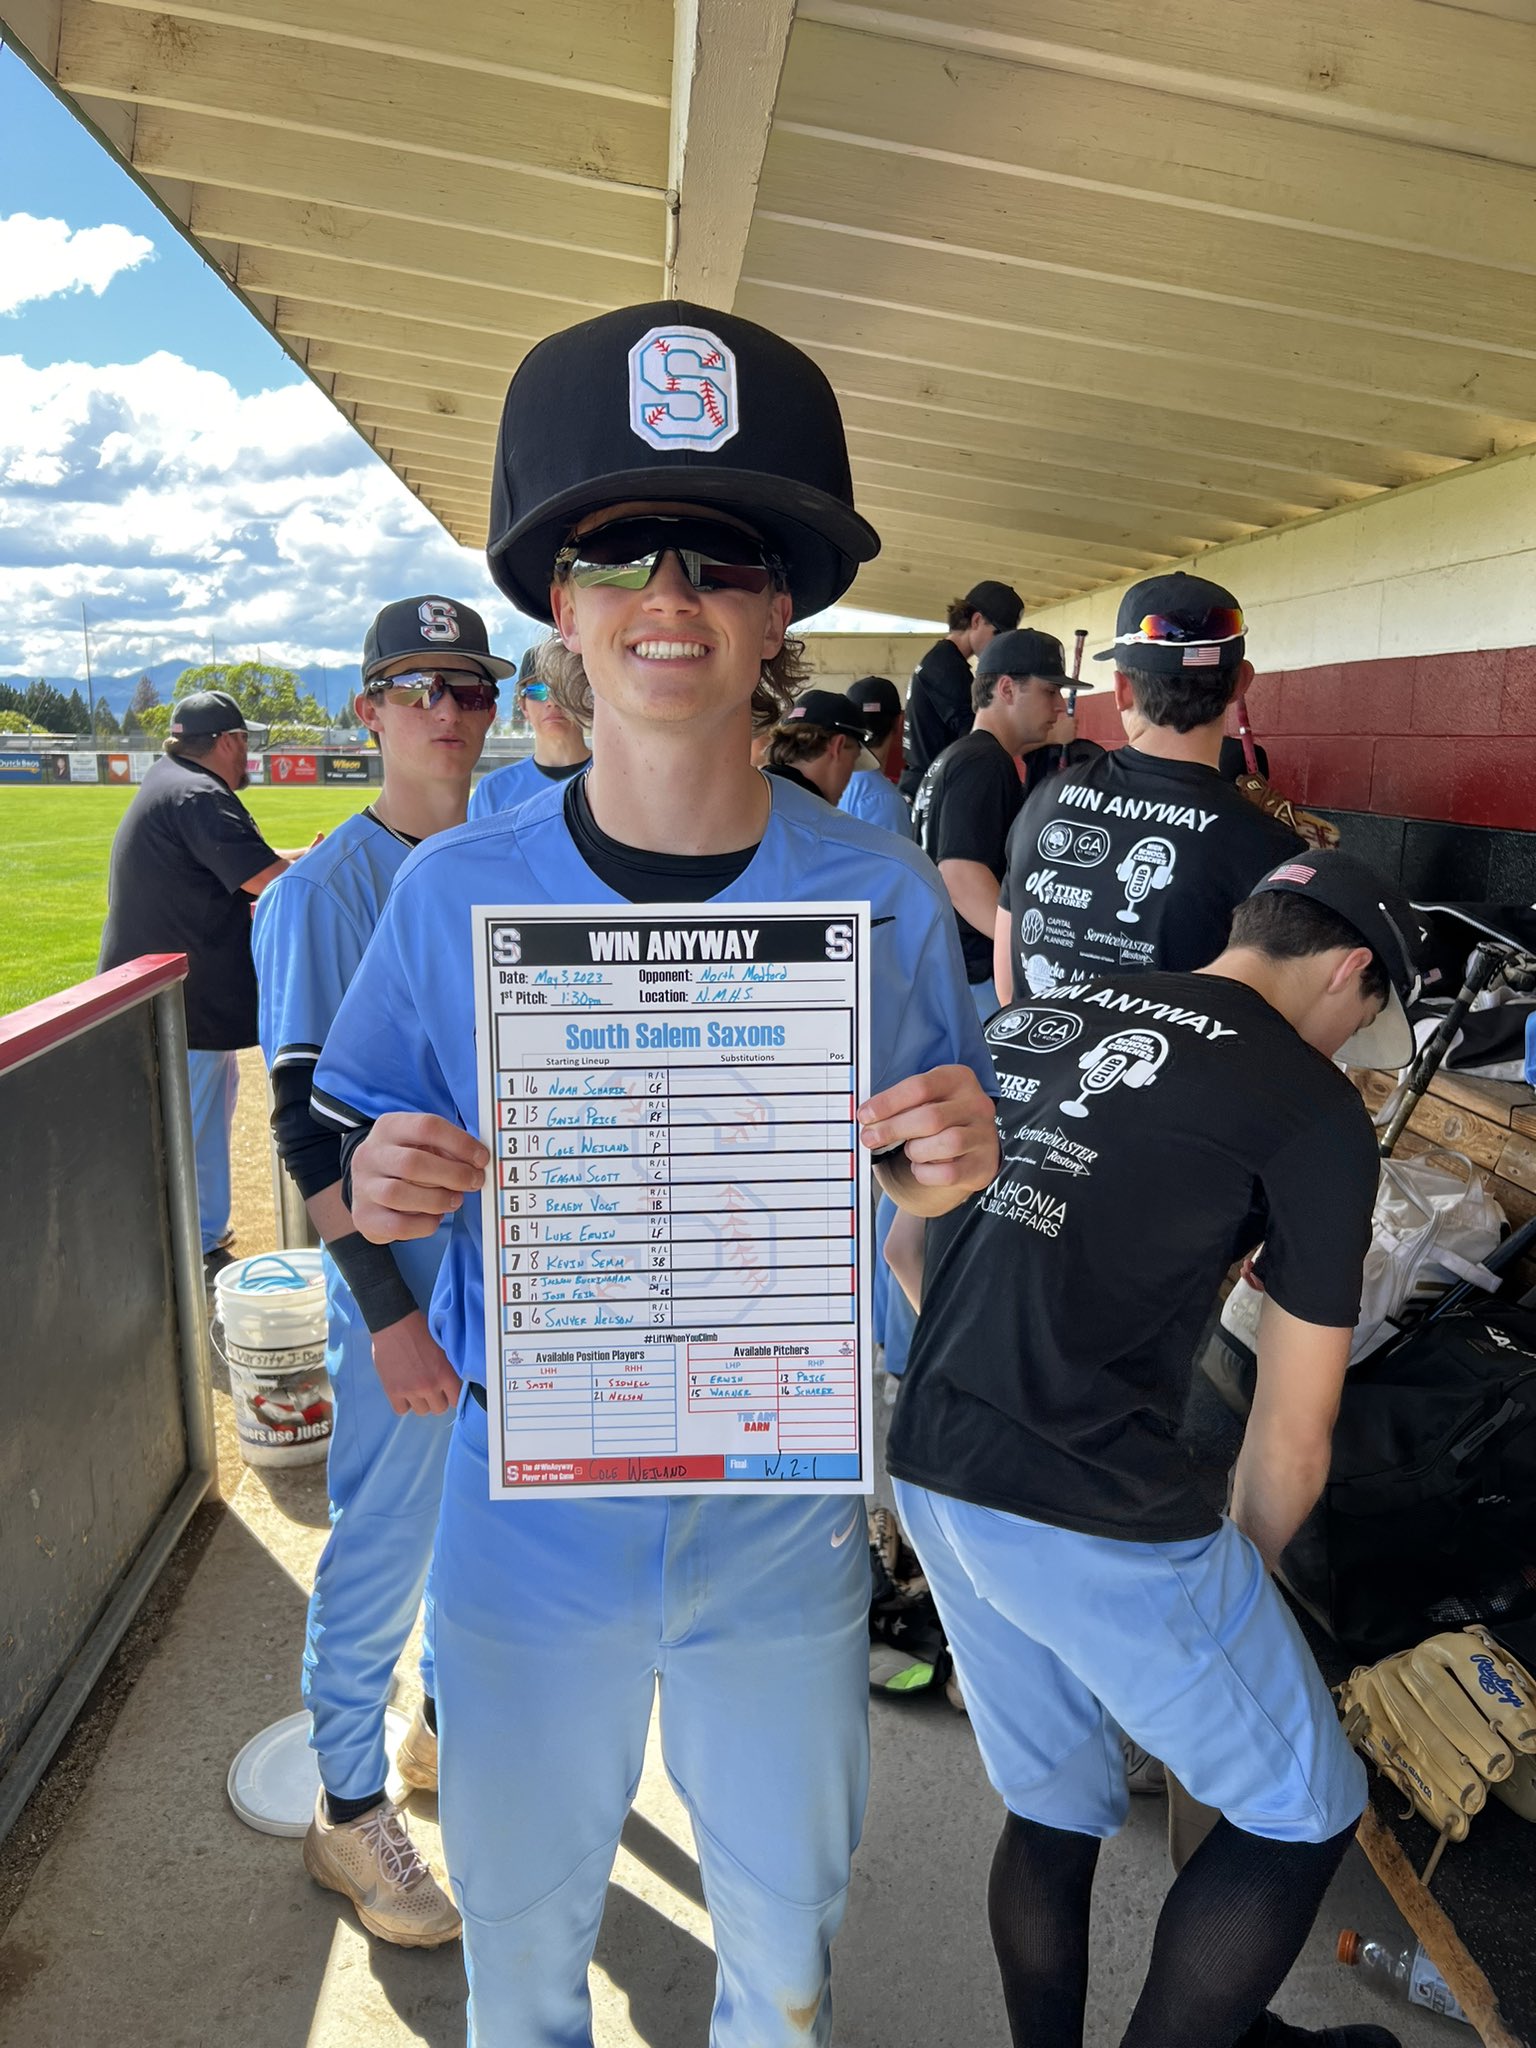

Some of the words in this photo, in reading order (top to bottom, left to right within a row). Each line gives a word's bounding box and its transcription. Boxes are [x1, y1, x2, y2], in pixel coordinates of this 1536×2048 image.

[628, 325, 739, 452] S
[418, 599, 460, 642] S
[1057, 784, 1104, 812] WIN
[1102, 795, 1219, 833] ANYWAY
[1078, 836, 1101, 853] GA
[1131, 868, 1148, 893] CLUB
[1054, 883, 1093, 902] TIRE
[1052, 895, 1089, 910] STORES
[1047, 918, 1071, 929] CAPITAL
[1043, 935, 1074, 948] PLANNERS
[1045, 927, 1076, 939] FINANCIAL
[493, 928, 521, 964] S
[589, 932, 640, 961] WIN
[646, 930, 759, 960] ANYWAY
[825, 924, 853, 960] S
[500, 971, 529, 984] Date:
[535, 970, 558, 989] May
[573, 972, 603, 983] 2023
[639, 969, 693, 985] Opponent:
[701, 965, 735, 982] North
[742, 963, 787, 982] Medford
[516, 991, 548, 1005] Pitch:
[639, 989, 689, 1003] Location:
[1031, 983, 1092, 1001] WIN
[1083, 987, 1239, 1041] ANYWAY
[566, 1023, 629, 1050] South
[636, 1022, 701, 1048] Salem
[707, 1021, 785, 1047] Saxons
[1038, 1020, 1069, 1039] GA
[1115, 1037, 1155, 1054] SCHOOL
[1129, 1034, 1155, 1045] HIGH
[721, 1054, 775, 1063] Substitutions
[1107, 1042, 1154, 1061] COACHES
[546, 1057, 580, 1067] Starting
[581, 1057, 610, 1066] Lineup
[1091, 1058, 1123, 1084] CLUB
[508, 1078, 515, 1095] 1
[525, 1075, 538, 1094] 16
[548, 1077, 578, 1095] NOAH
[649, 1083, 662, 1094] CF
[1001, 1088, 1032, 1103] ORES
[507, 1108, 517, 1125] 2
[525, 1105, 538, 1124] 13
[546, 1107, 580, 1127] GAVIN
[586, 1107, 617, 1125] PRICE
[649, 1112, 662, 1122] RF
[508, 1137, 518, 1154] 3
[528, 1135, 540, 1153] 19
[546, 1137, 575, 1157] COLE
[653, 1142, 661, 1154] P
[1046, 1150, 1082, 1172] Restore
[508, 1167, 519, 1183] 4
[529, 1161, 540, 1182] 5
[586, 1165, 621, 1183] SCOTT
[654, 1171, 663, 1180] C
[510, 1196, 520, 1213] 5
[528, 1193, 537, 1209] 3
[590, 1195, 620, 1211] VOGT
[1005, 1205, 1061, 1237] AFFAIRS
[510, 1225, 520, 1242] 6
[530, 1221, 538, 1239] 4
[545, 1226, 572, 1241] LUKE
[579, 1225, 616, 1242] ERWIN
[652, 1228, 663, 1238] LF
[511, 1254, 521, 1271] 7
[530, 1251, 539, 1270] 8
[546, 1255, 584, 1271] KEVIN
[652, 1257, 665, 1267] 3B
[512, 1282, 522, 1300] 8
[530, 1278, 537, 1287] 2
[531, 1293, 538, 1301] 11
[543, 1291, 566, 1300] JOSH
[512, 1311, 522, 1328] 9
[531, 1308, 541, 1324] 6
[594, 1306, 633, 1325] NELSON
[652, 1313, 665, 1323] SS
[644, 1333, 718, 1345] #LiftWhenYouClimb
[535, 1351, 575, 1363] Available
[576, 1350, 610, 1361] Position
[612, 1349, 645, 1361] Players
[734, 1346, 772, 1357] Available
[773, 1345, 809, 1356] Pitchers
[540, 1367, 557, 1375] LHH
[807, 1359, 824, 1367] RHP
[508, 1380, 519, 1390] 12
[526, 1380, 554, 1390] SMITH
[691, 1375, 697, 1384] 4
[709, 1375, 743, 1383] ERWIN
[780, 1373, 789, 1382] 13
[796, 1372, 826, 1382] PRICE
[594, 1391, 603, 1402] 21
[608, 1393, 643, 1401] NELSON
[691, 1389, 701, 1397] 15
[710, 1388, 752, 1397] WAGNER
[781, 1386, 790, 1395] 16
[737, 1412, 755, 1422] THE
[296, 1420, 329, 1441] JUGS
[744, 1422, 770, 1432] BARN
[506, 1465, 519, 1481] S
[589, 1459, 618, 1479] COLE
